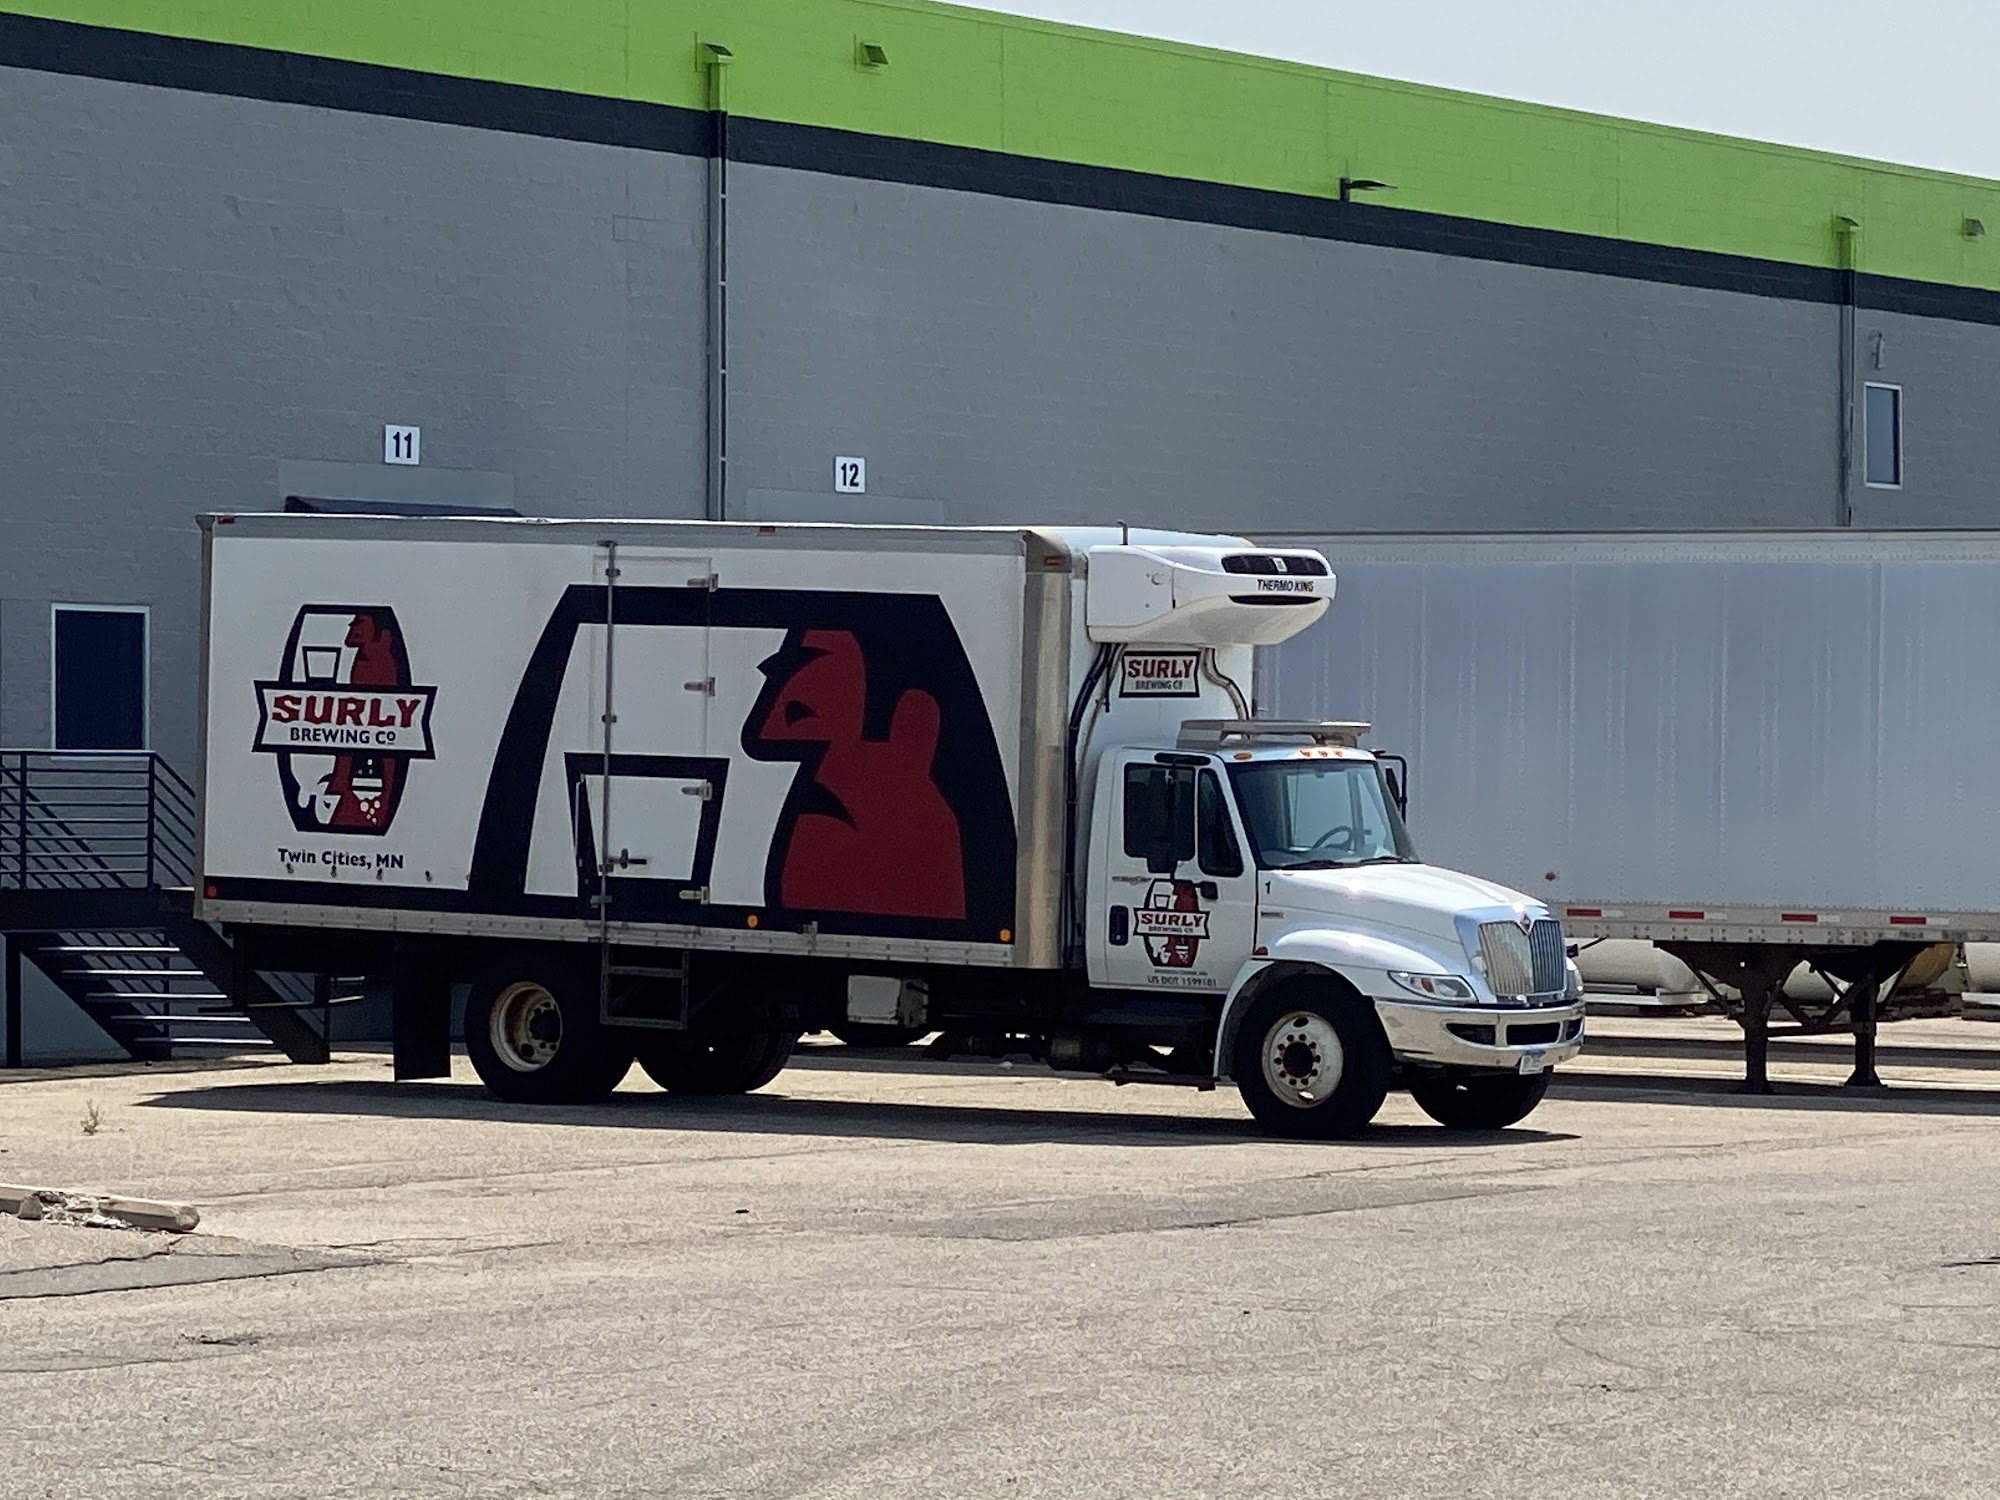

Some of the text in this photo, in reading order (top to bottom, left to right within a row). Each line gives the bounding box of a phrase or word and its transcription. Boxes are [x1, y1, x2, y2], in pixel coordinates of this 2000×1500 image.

[392, 431, 412, 459] 11
[841, 462, 859, 487] 12
[1257, 579, 1314, 593] THERMO KING
[1128, 659, 1194, 679] SURLY
[1135, 680, 1172, 690] BREWING
[271, 695, 421, 728] SURLY
[290, 727, 370, 744] BREWING
[278, 848, 404, 869] Twin Cities, MN
[1265, 880, 1271, 895] 1
[1141, 913, 1203, 927] SURLY
[1147, 975, 1159, 984] US
[1161, 976, 1180, 985] DOT
